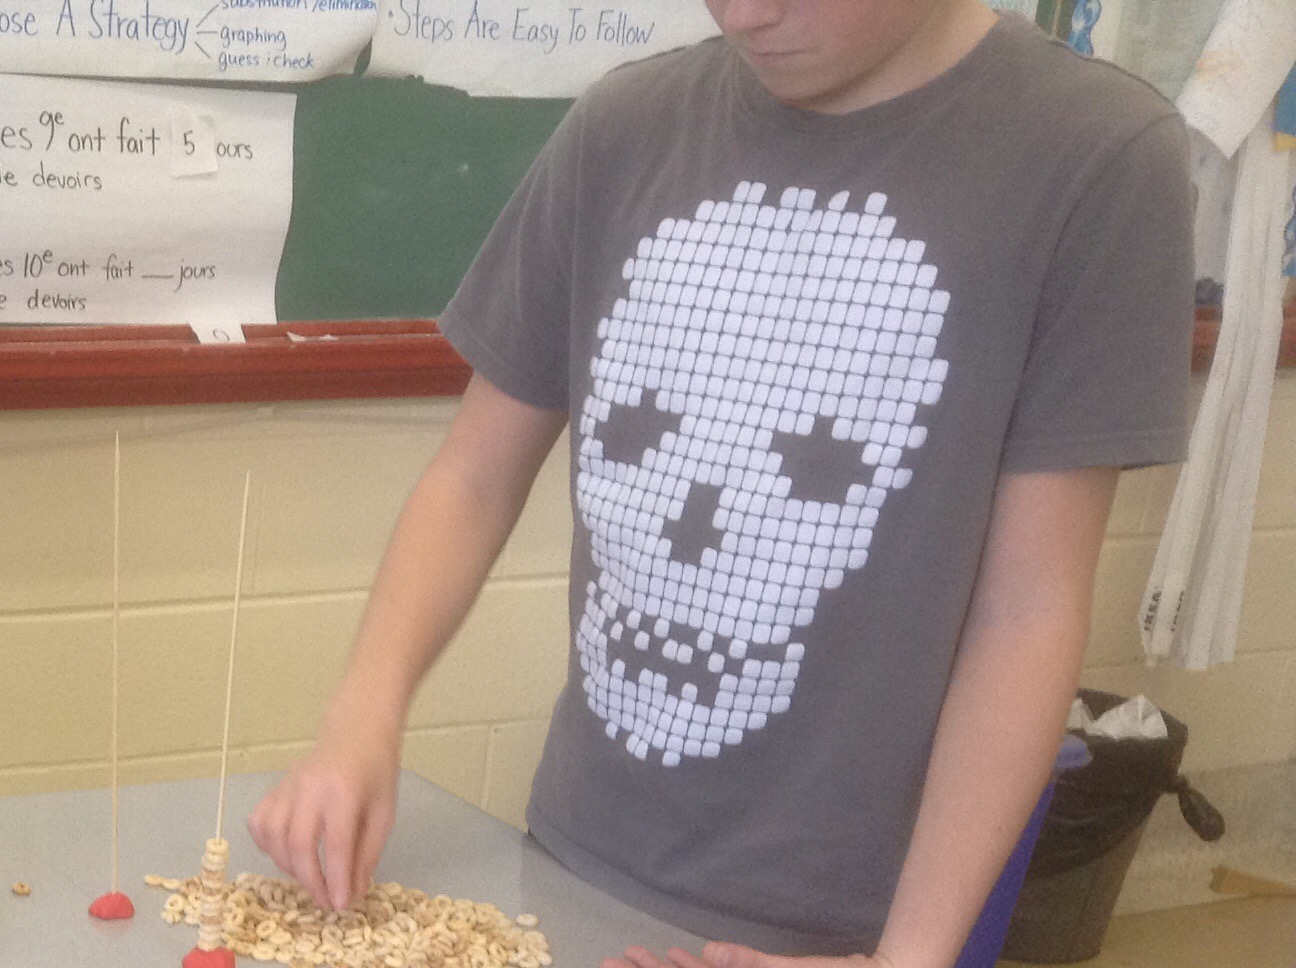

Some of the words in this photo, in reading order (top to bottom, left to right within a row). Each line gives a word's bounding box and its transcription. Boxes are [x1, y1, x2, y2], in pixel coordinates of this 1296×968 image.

[56, 0, 76, 37] A
[89, 0, 189, 54] Strategy
[220, 25, 287, 51] graphing
[394, 0, 453, 43] Steps
[464, 0, 500, 40] Are
[512, 8, 559, 54] Easy
[569, 8, 586, 44] To
[597, 10, 655, 45] Follow
[218, 52, 259, 71] guess
[273, 52, 313, 68] check
[68, 127, 106, 152] ont
[116, 116, 162, 155] fait
[183, 130, 195, 156] 5
[32, 161, 102, 191] devoirs
[57, 259, 91, 277] ont
[102, 253, 133, 281] fait
[173, 258, 217, 293] jours
[27, 288, 87, 310] devoirs
